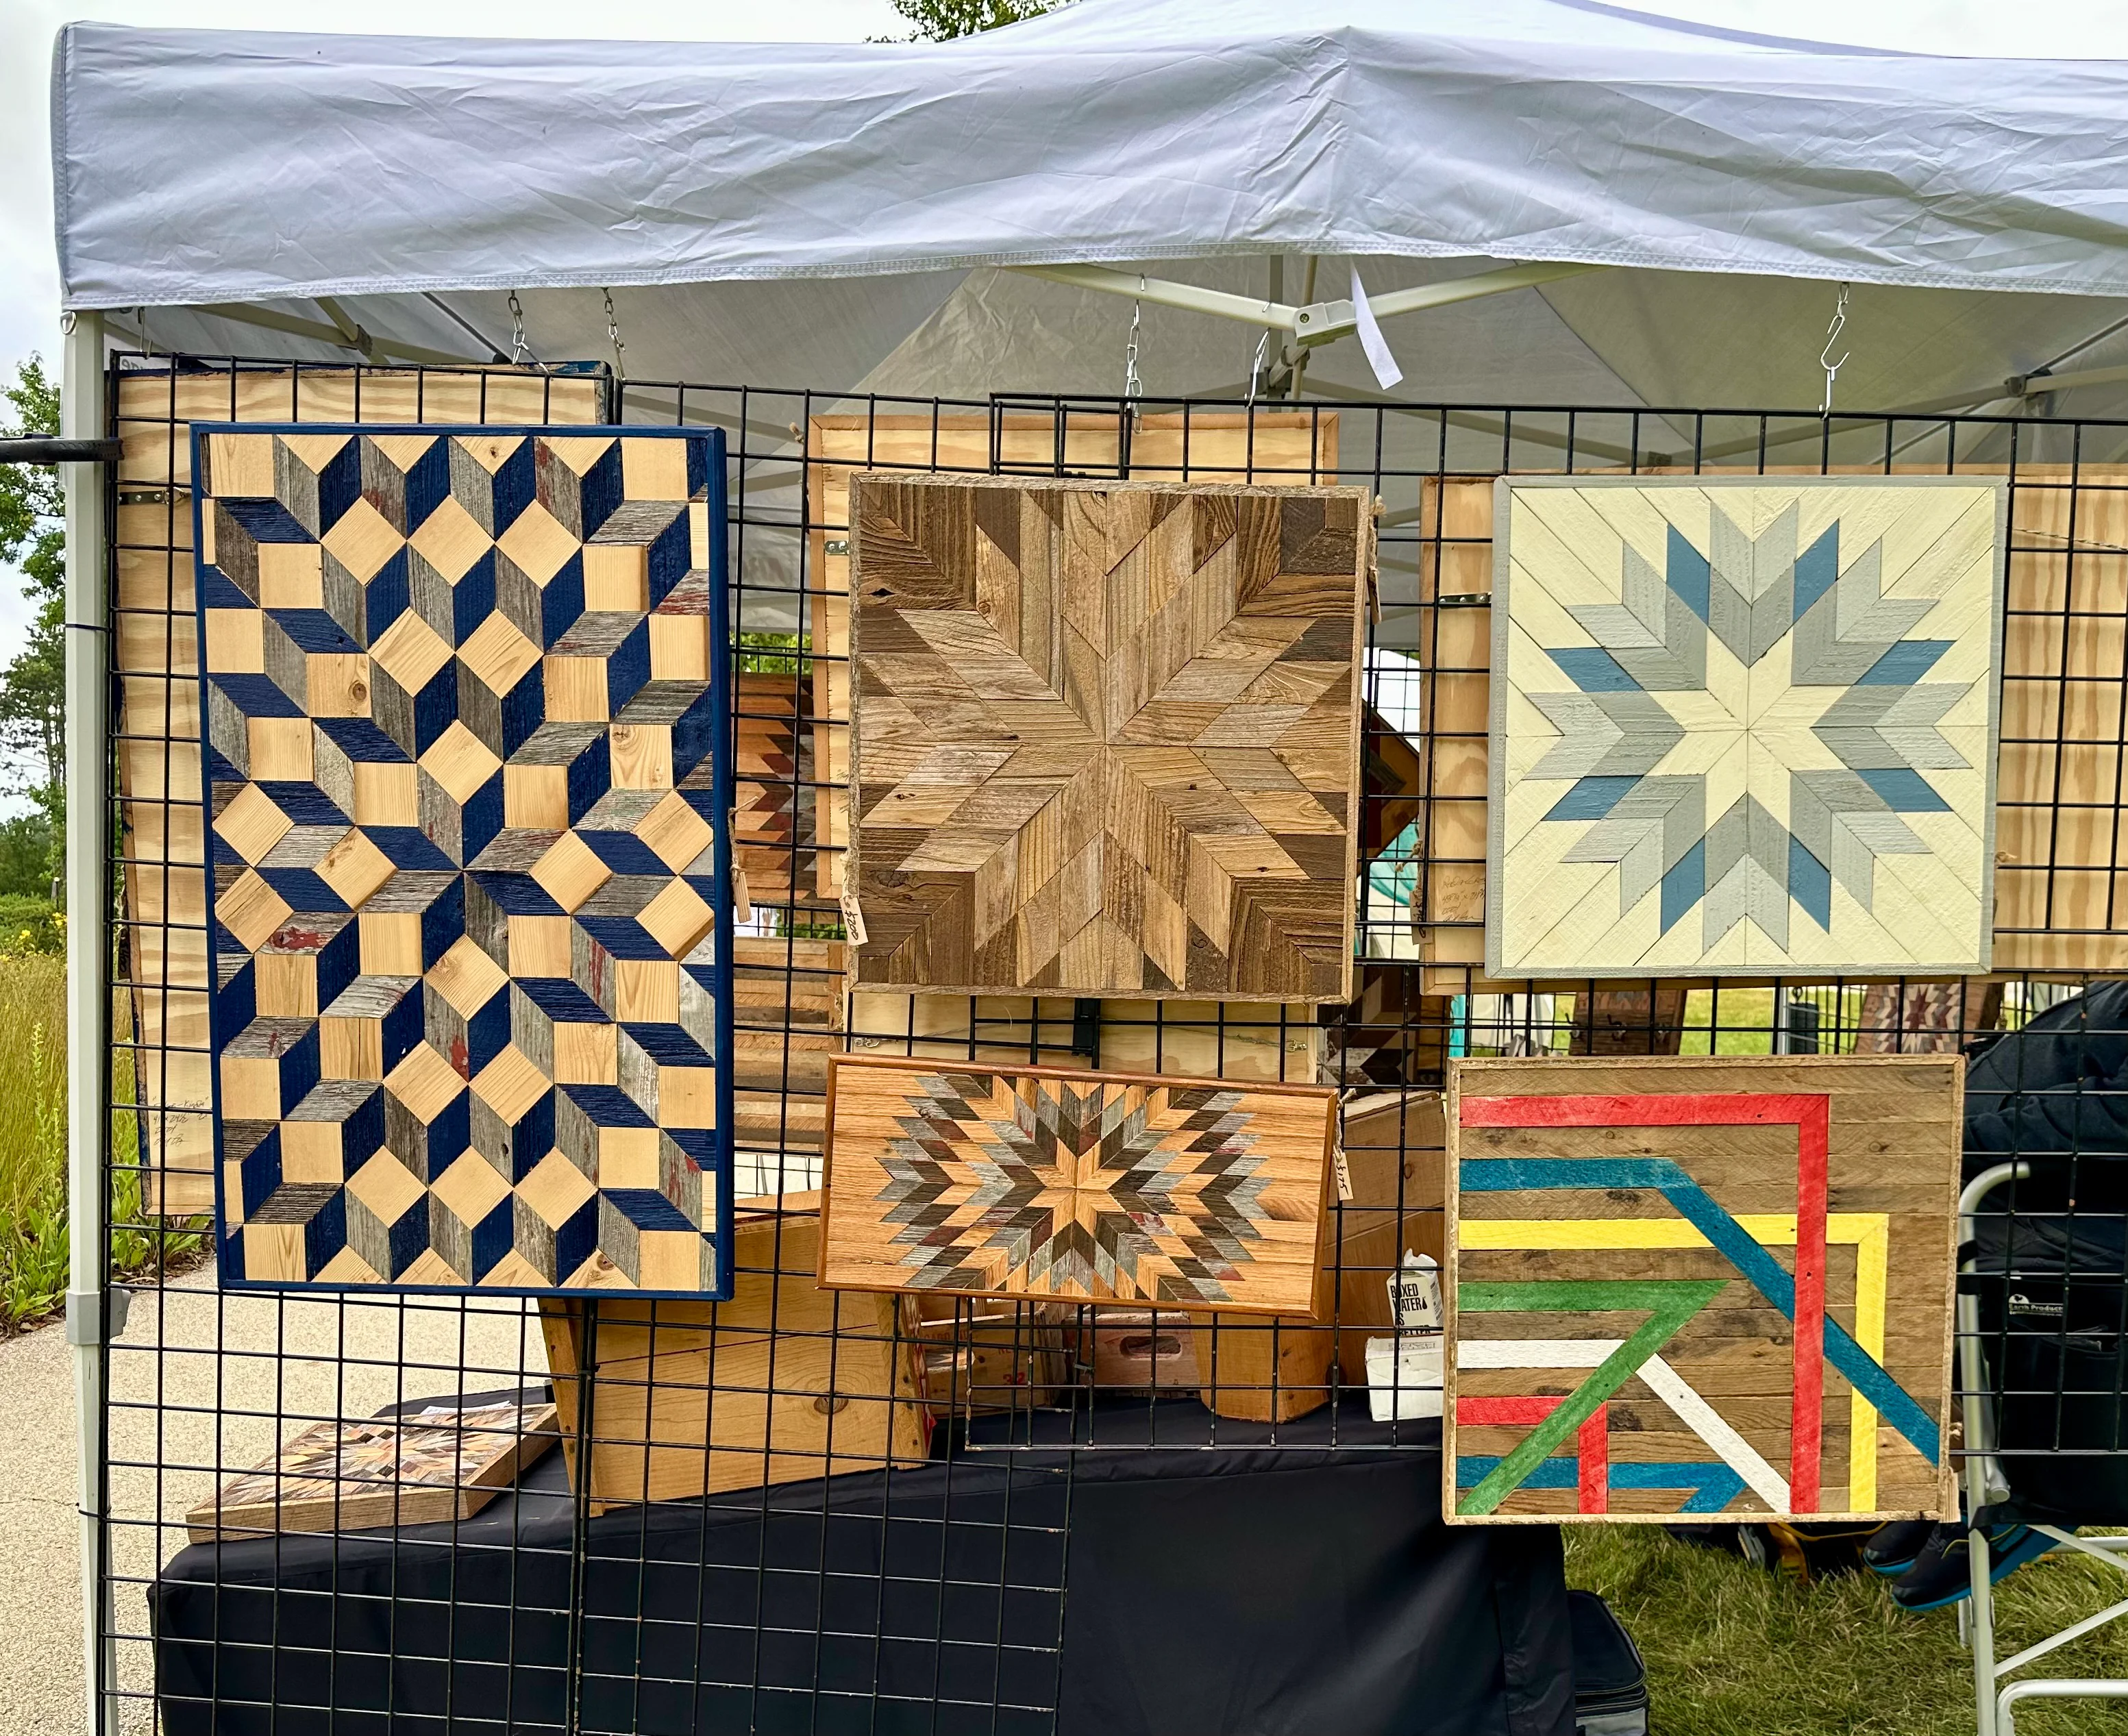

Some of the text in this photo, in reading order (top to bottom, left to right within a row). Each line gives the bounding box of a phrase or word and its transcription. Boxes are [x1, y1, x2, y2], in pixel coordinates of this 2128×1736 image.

[845, 910, 858, 940] $200
[1336, 1165, 1349, 1195] $175
[1390, 1283, 1419, 1298] BXED
